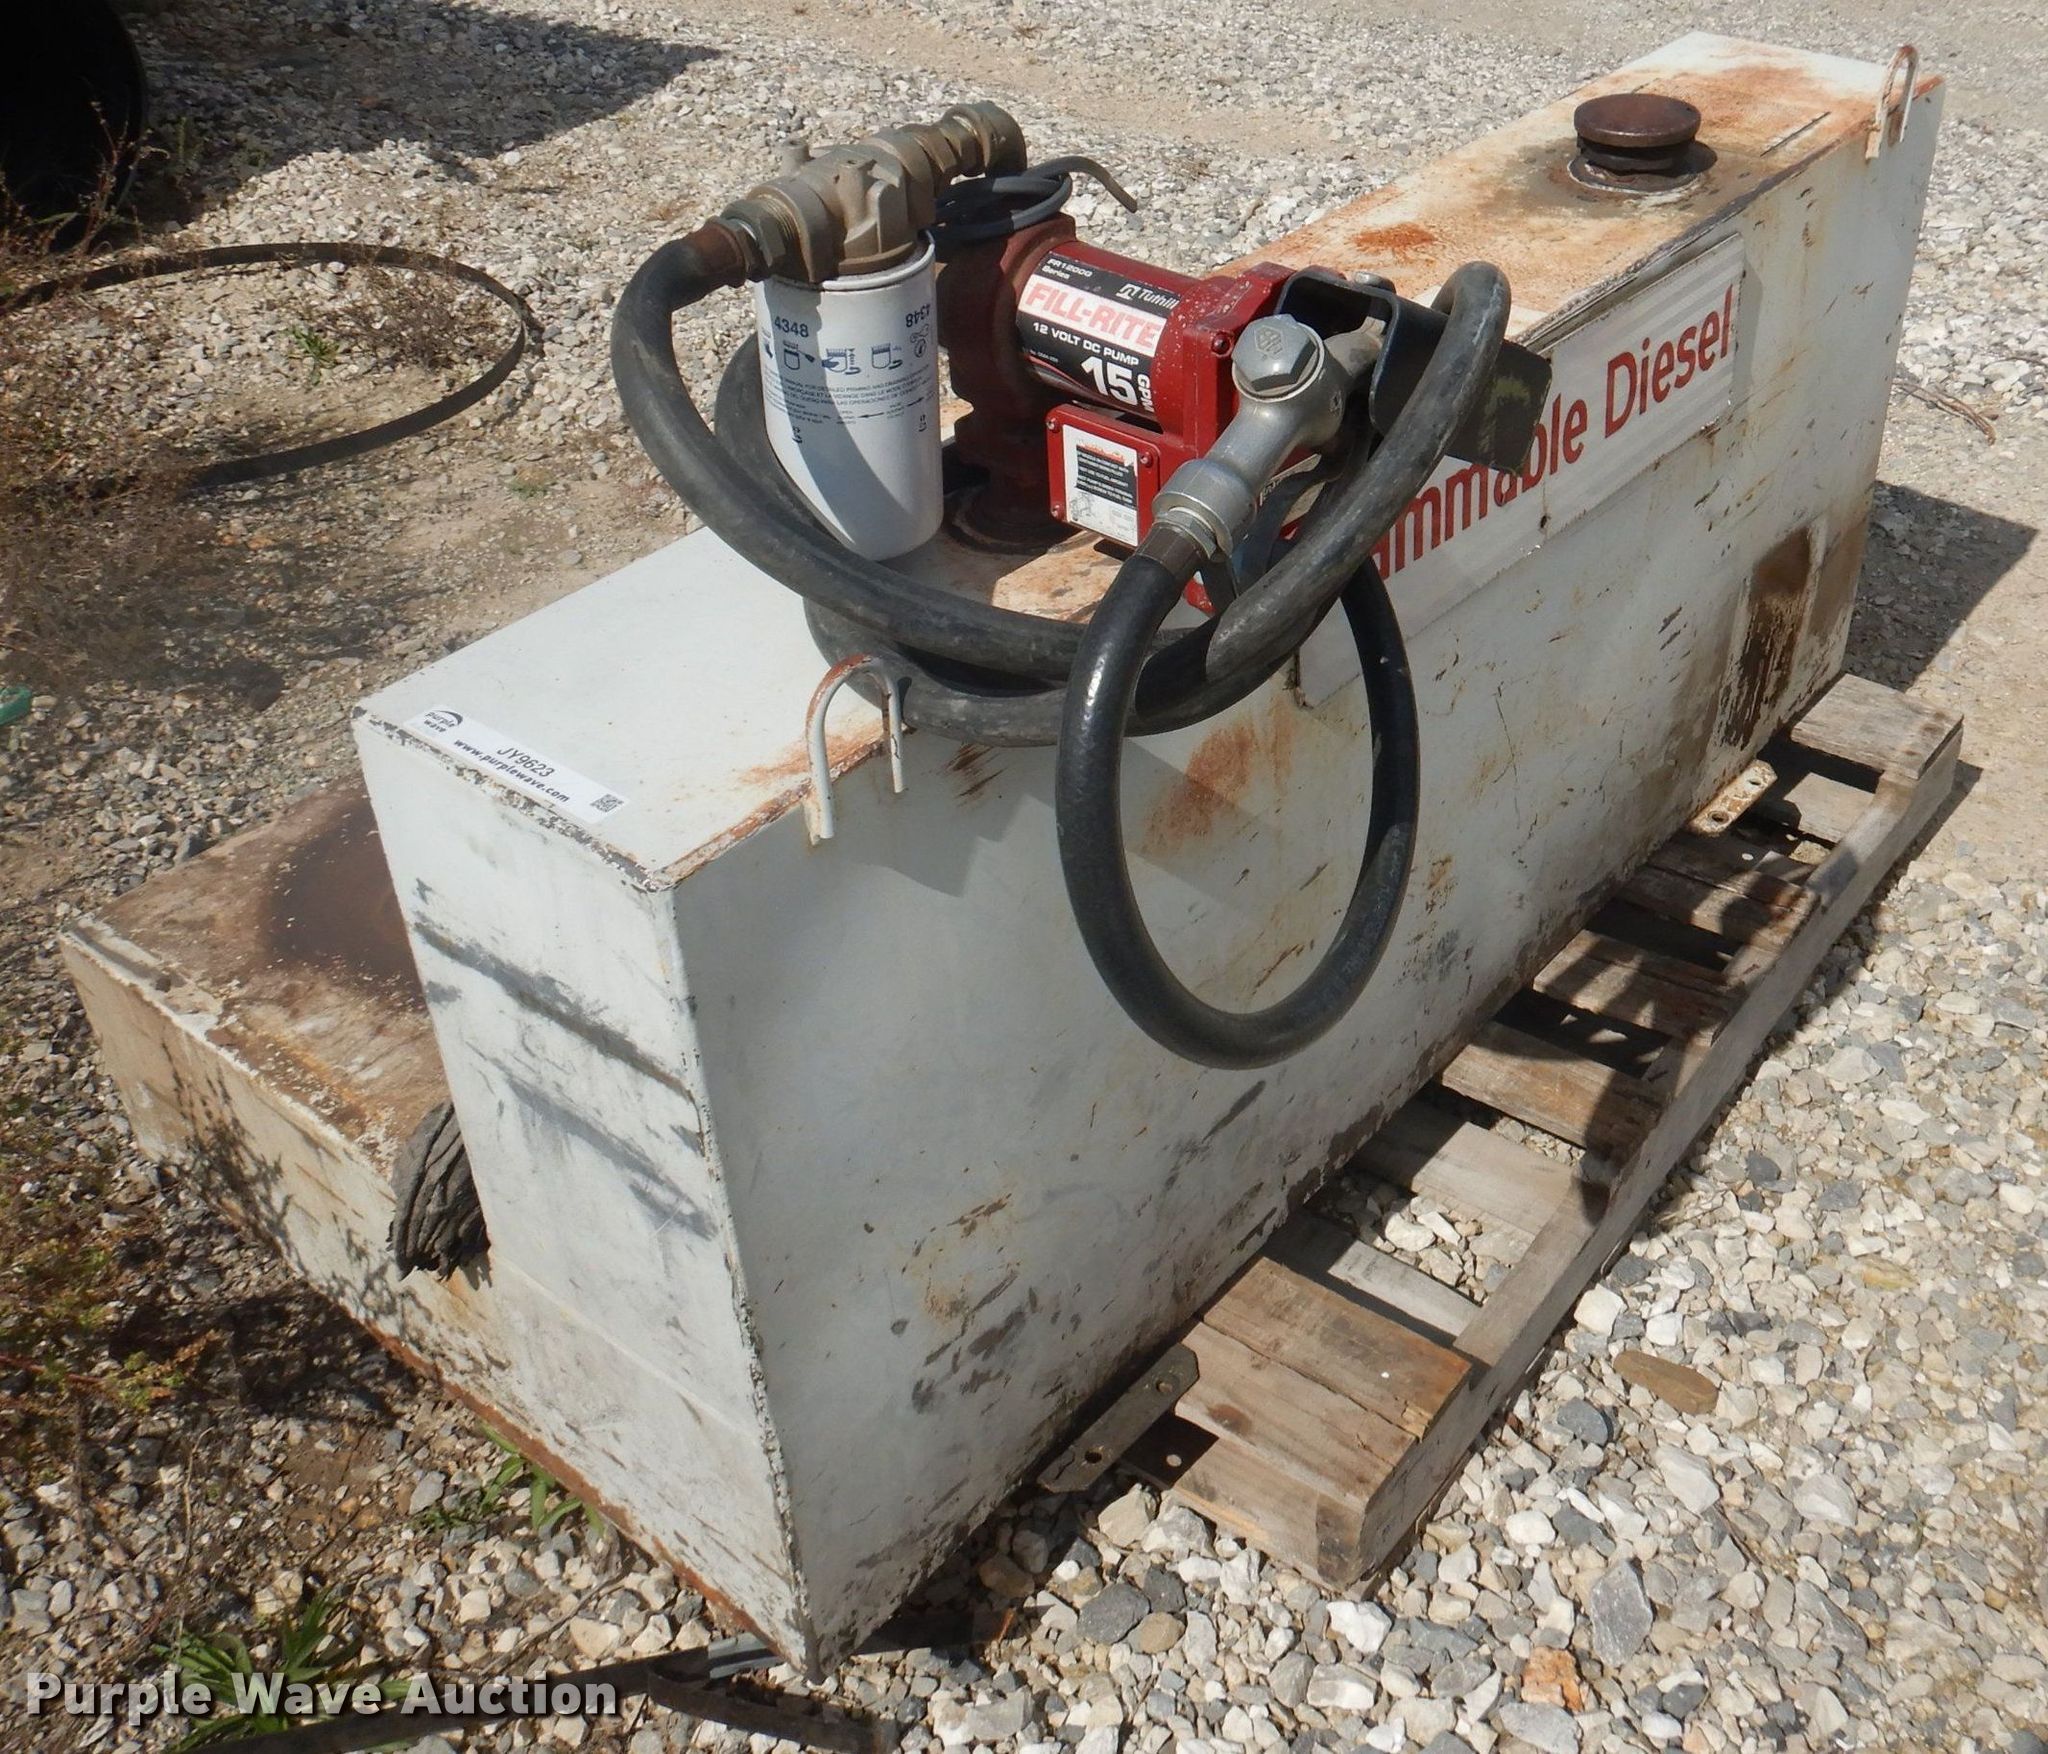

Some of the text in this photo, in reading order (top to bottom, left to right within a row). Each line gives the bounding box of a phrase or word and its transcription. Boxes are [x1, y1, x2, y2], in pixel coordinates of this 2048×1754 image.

[1041, 265, 1071, 281] Series
[1025, 281, 1162, 348] FILL-RITE
[1137, 288, 1180, 309] Tuthill
[774, 316, 809, 338] 4348
[1033, 322, 1140, 366] 12 VOLT DC PUMP
[1081, 356, 1138, 406] 15
[1604, 283, 1734, 440] Diesel
[453, 739, 571, 803] www.purplewave.com
[497, 747, 556, 778] JY9623
